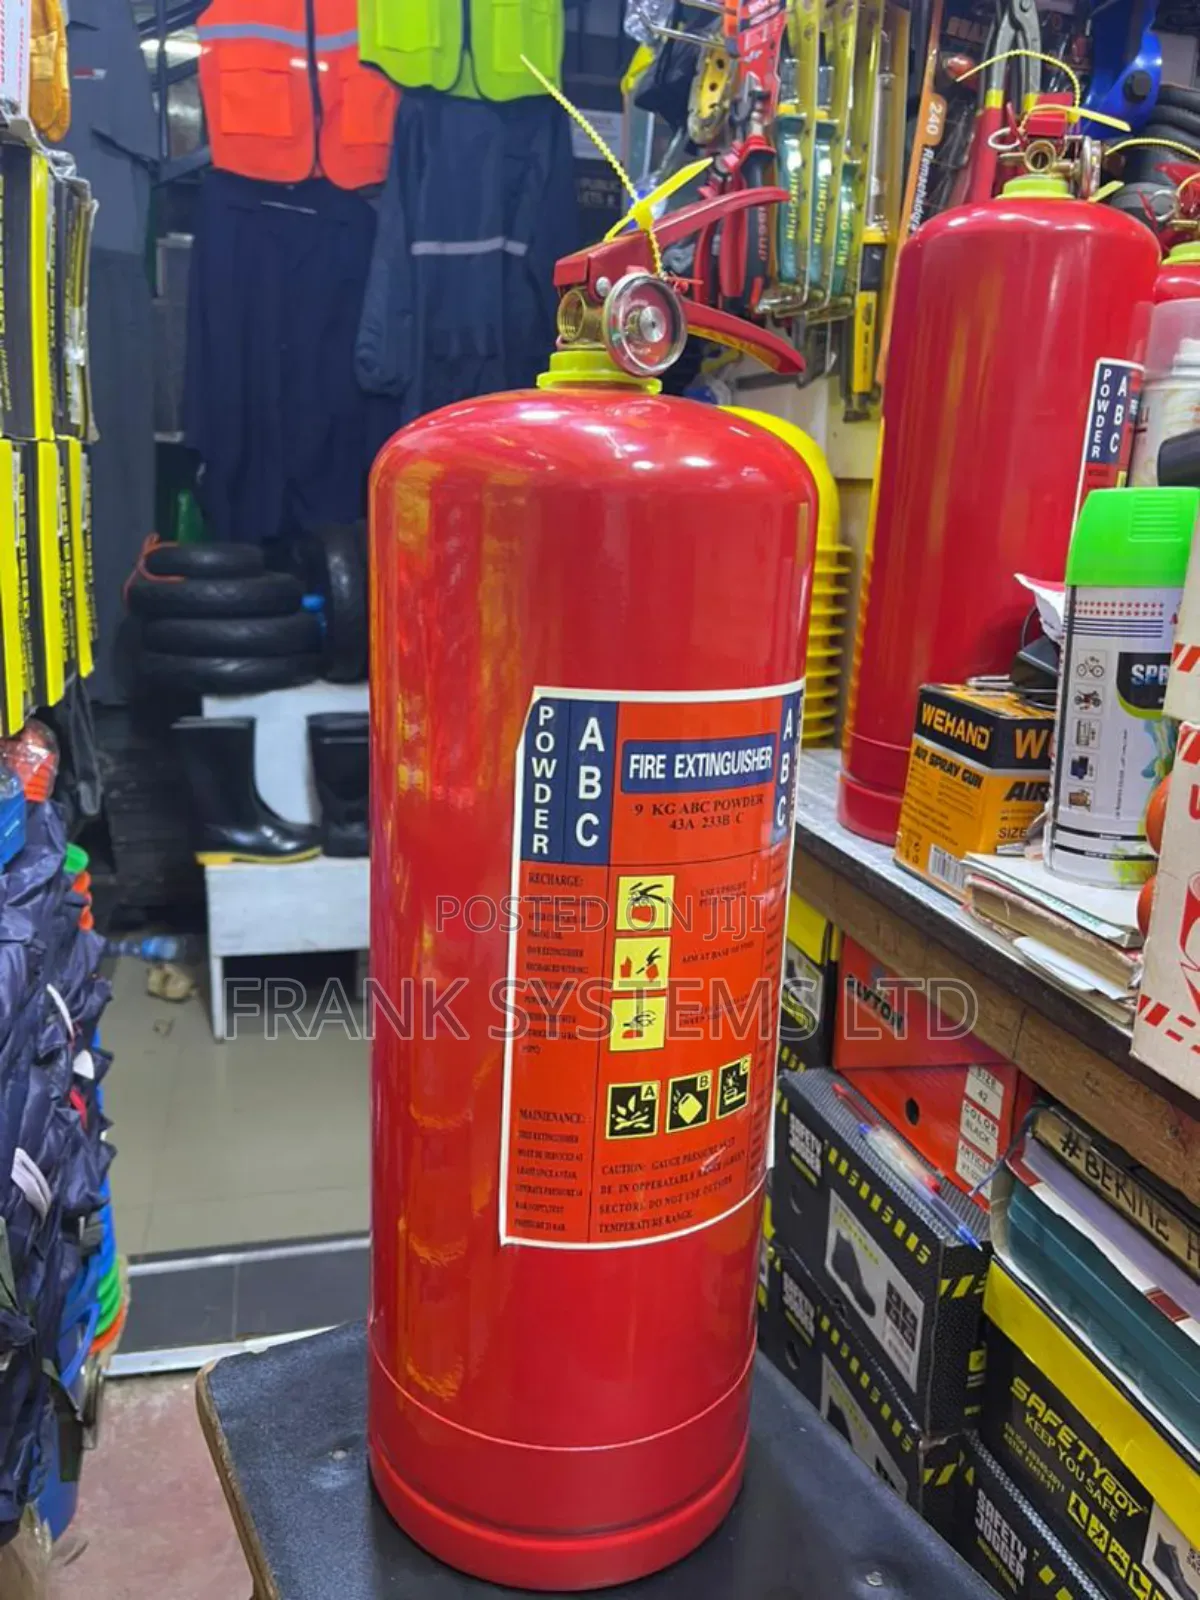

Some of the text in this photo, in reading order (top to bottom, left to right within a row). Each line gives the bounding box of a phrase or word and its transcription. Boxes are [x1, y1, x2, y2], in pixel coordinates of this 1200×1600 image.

[926, 101, 943, 136] 240
[1091, 368, 1112, 458] POWDER
[1109, 376, 1127, 453] ABC
[922, 702, 991, 752] WEHAND
[531, 705, 557, 854] POWDER
[575, 716, 605, 847] ABC
[629, 745, 773, 780] FIRE EXTINGUISHER
[776, 707, 793, 827] ABC
[928, 752, 961, 777] SPRAY
[961, 768, 985, 789] GUN
[634, 793, 765, 816] 9 KG ABC POWDER
[669, 818, 695, 831] 43A
[701, 814, 731, 829] 233B
[998, 827, 1025, 840] SIZE
[699, 1075, 709, 1088] B
[741, 1059, 749, 1074] C
[643, 1085, 656, 1098] A
[619, 1183, 630, 1193] IN
[1009, 1375, 1143, 1518] SAFETYBOY
[1024, 1412, 1056, 1449] KEEP
[1057, 1447, 1085, 1482] YOU
[1084, 1478, 1118, 1523] SAFE
[976, 1487, 1028, 1563] SAFETY
[974, 1510, 1025, 1586] JOGGER
